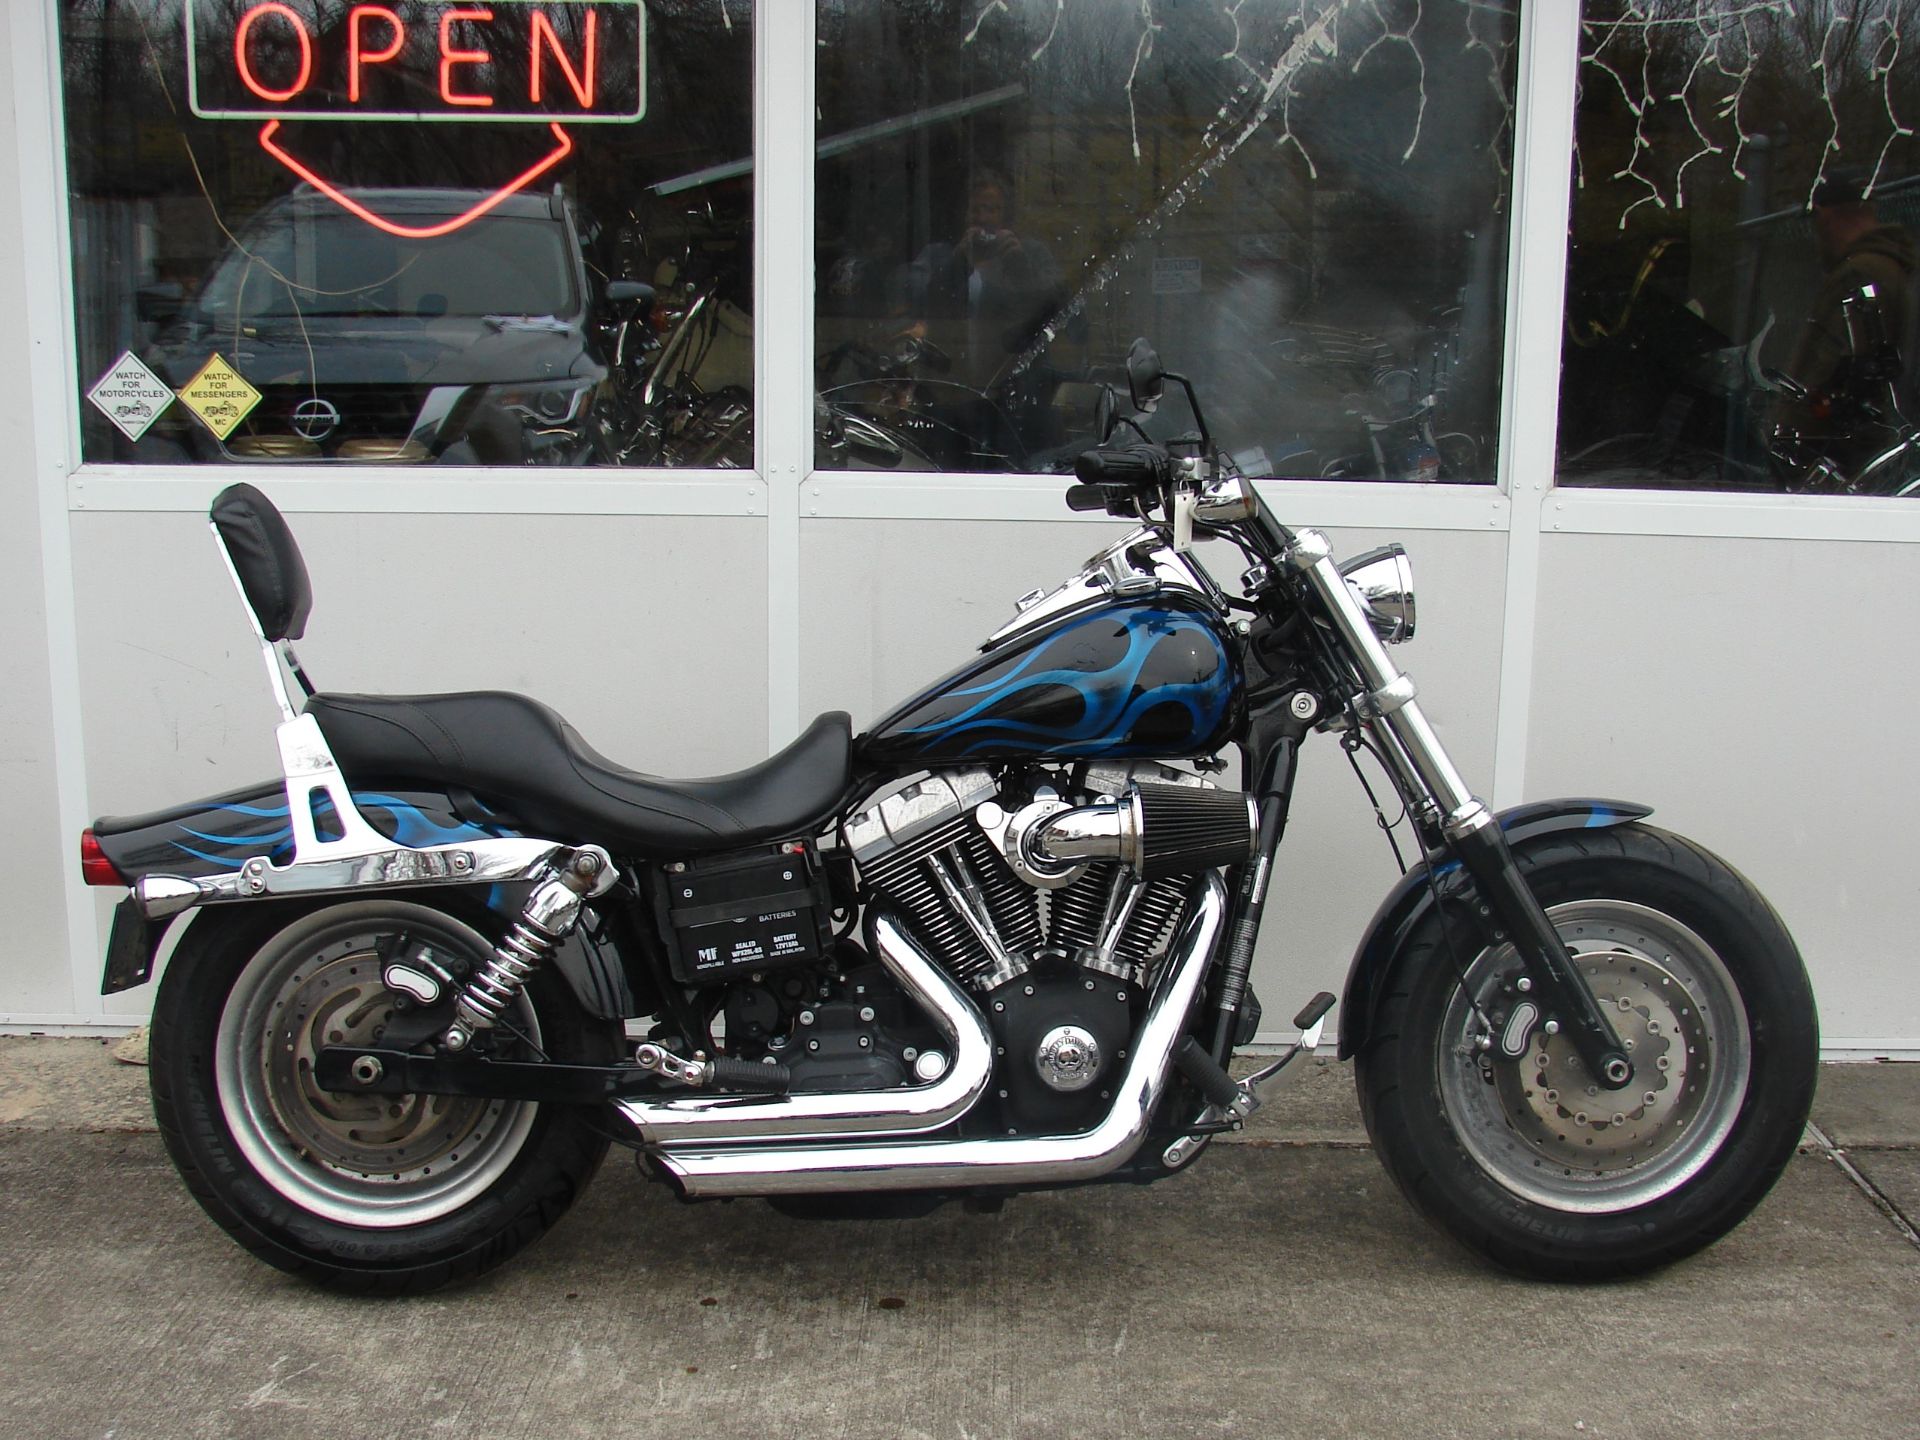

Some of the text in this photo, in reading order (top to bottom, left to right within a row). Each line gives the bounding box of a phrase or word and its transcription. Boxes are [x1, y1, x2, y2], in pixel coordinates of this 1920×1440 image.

[235, 2, 598, 109] OPEN
[115, 372, 146, 380] WATCH
[204, 373, 234, 381] WATCH
[122, 381, 141, 389] FOR
[99, 390, 165, 398] MOTORCYCLES
[758, 910, 797, 923] BATTERIES
[735, 933, 797, 950] SEALED BATTERY
[698, 947, 718, 963] MF
